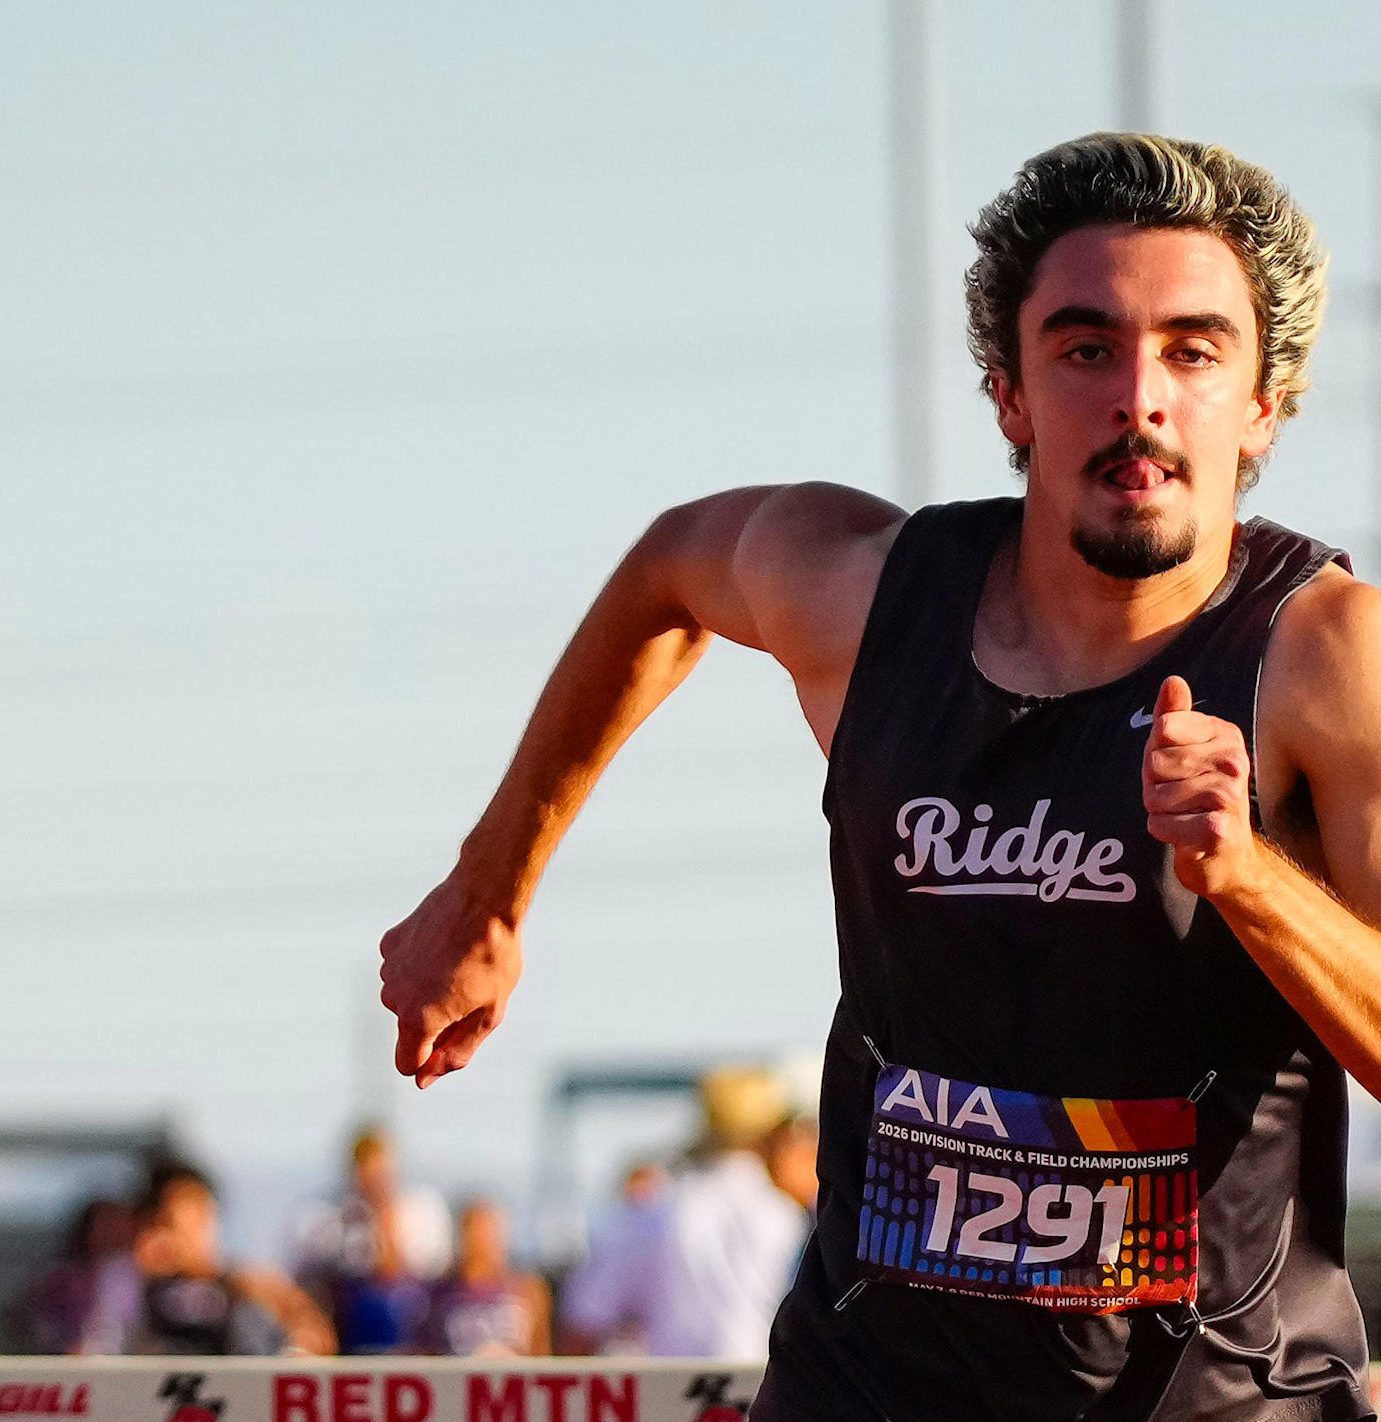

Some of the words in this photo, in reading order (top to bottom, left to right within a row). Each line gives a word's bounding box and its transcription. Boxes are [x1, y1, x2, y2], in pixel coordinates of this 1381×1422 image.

[894, 797, 1137, 902] Ridge
[880, 1069, 1009, 1138] AIA
[877, 1122, 909, 1140] 2026
[910, 1130, 966, 1154] DIVISION
[967, 1143, 1013, 1162] TRACK
[1014, 1151, 1026, 1163] &
[1028, 1151, 1068, 1168] FIELD
[1070, 1152, 1190, 1170] CHAMPIONSHIPS
[926, 1164, 1130, 1265] 1291
[1056, 1297, 1088, 1308] HIGH
[1090, 1296, 1142, 1308] SCHOOL
